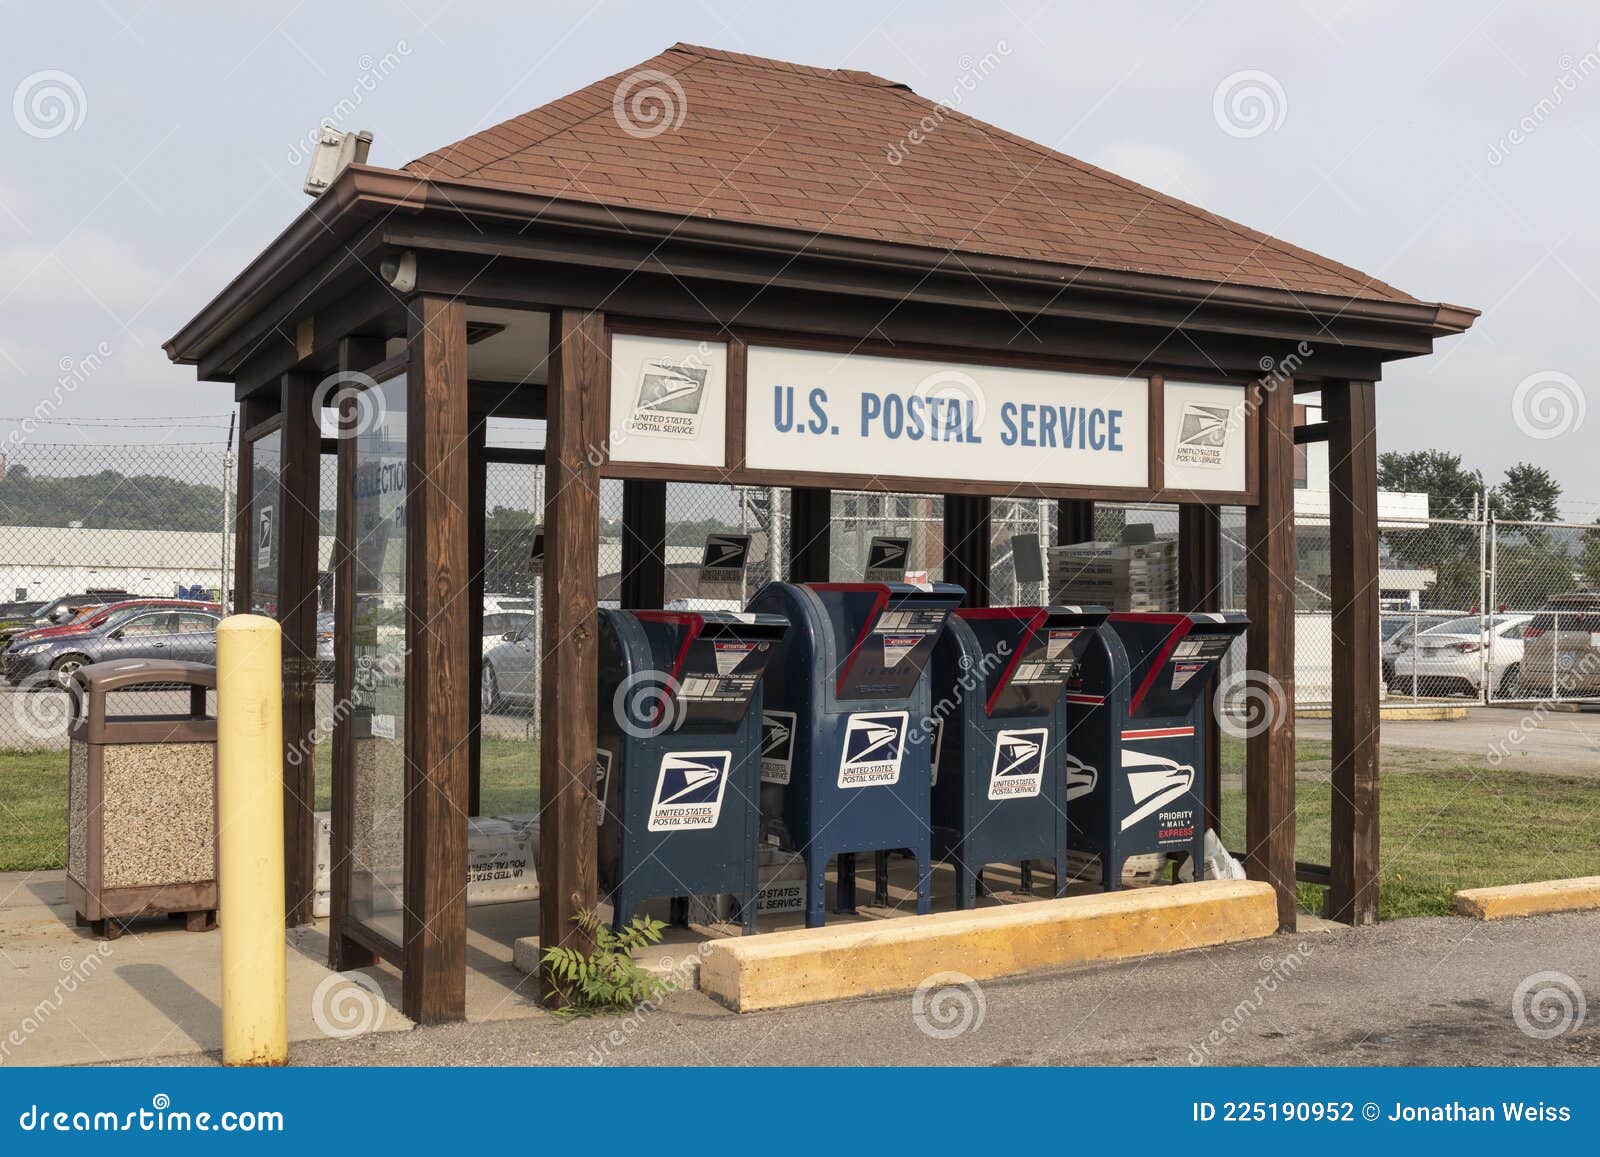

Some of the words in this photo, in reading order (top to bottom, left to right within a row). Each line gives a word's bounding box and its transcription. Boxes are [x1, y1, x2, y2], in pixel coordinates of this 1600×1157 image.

[634, 414, 665, 424] UNITED
[665, 416, 693, 426] STATES
[773, 385, 840, 435] U.S.
[861, 392, 982, 444] POSTAL
[1000, 401, 1124, 452] SERVICE
[631, 422, 662, 433] POSTAL
[662, 425, 695, 435] SERVICE
[843, 767, 870, 776] UNITED
[870, 764, 894, 774] STATES
[842, 775, 868, 784] POSTAL
[868, 773, 895, 782] SERVICE
[993, 780, 1015, 788] UNITED
[1015, 778, 1036, 787] STATES
[992, 787, 1013, 796] POSTAL
[1013, 785, 1037, 794] SERVICE
[654, 808, 685, 818] UNITED
[685, 807, 712, 816] STATES
[1158, 811, 1193, 820] PRIORITY
[653, 816, 682, 826] POSTAL
[682, 816, 713, 825] SERVICE
[1166, 820, 1185, 828] MAIL
[1158, 828, 1193, 838] EXPRESS
[767, 887, 800, 898] STATES
[766, 897, 804, 909] SERVICE
